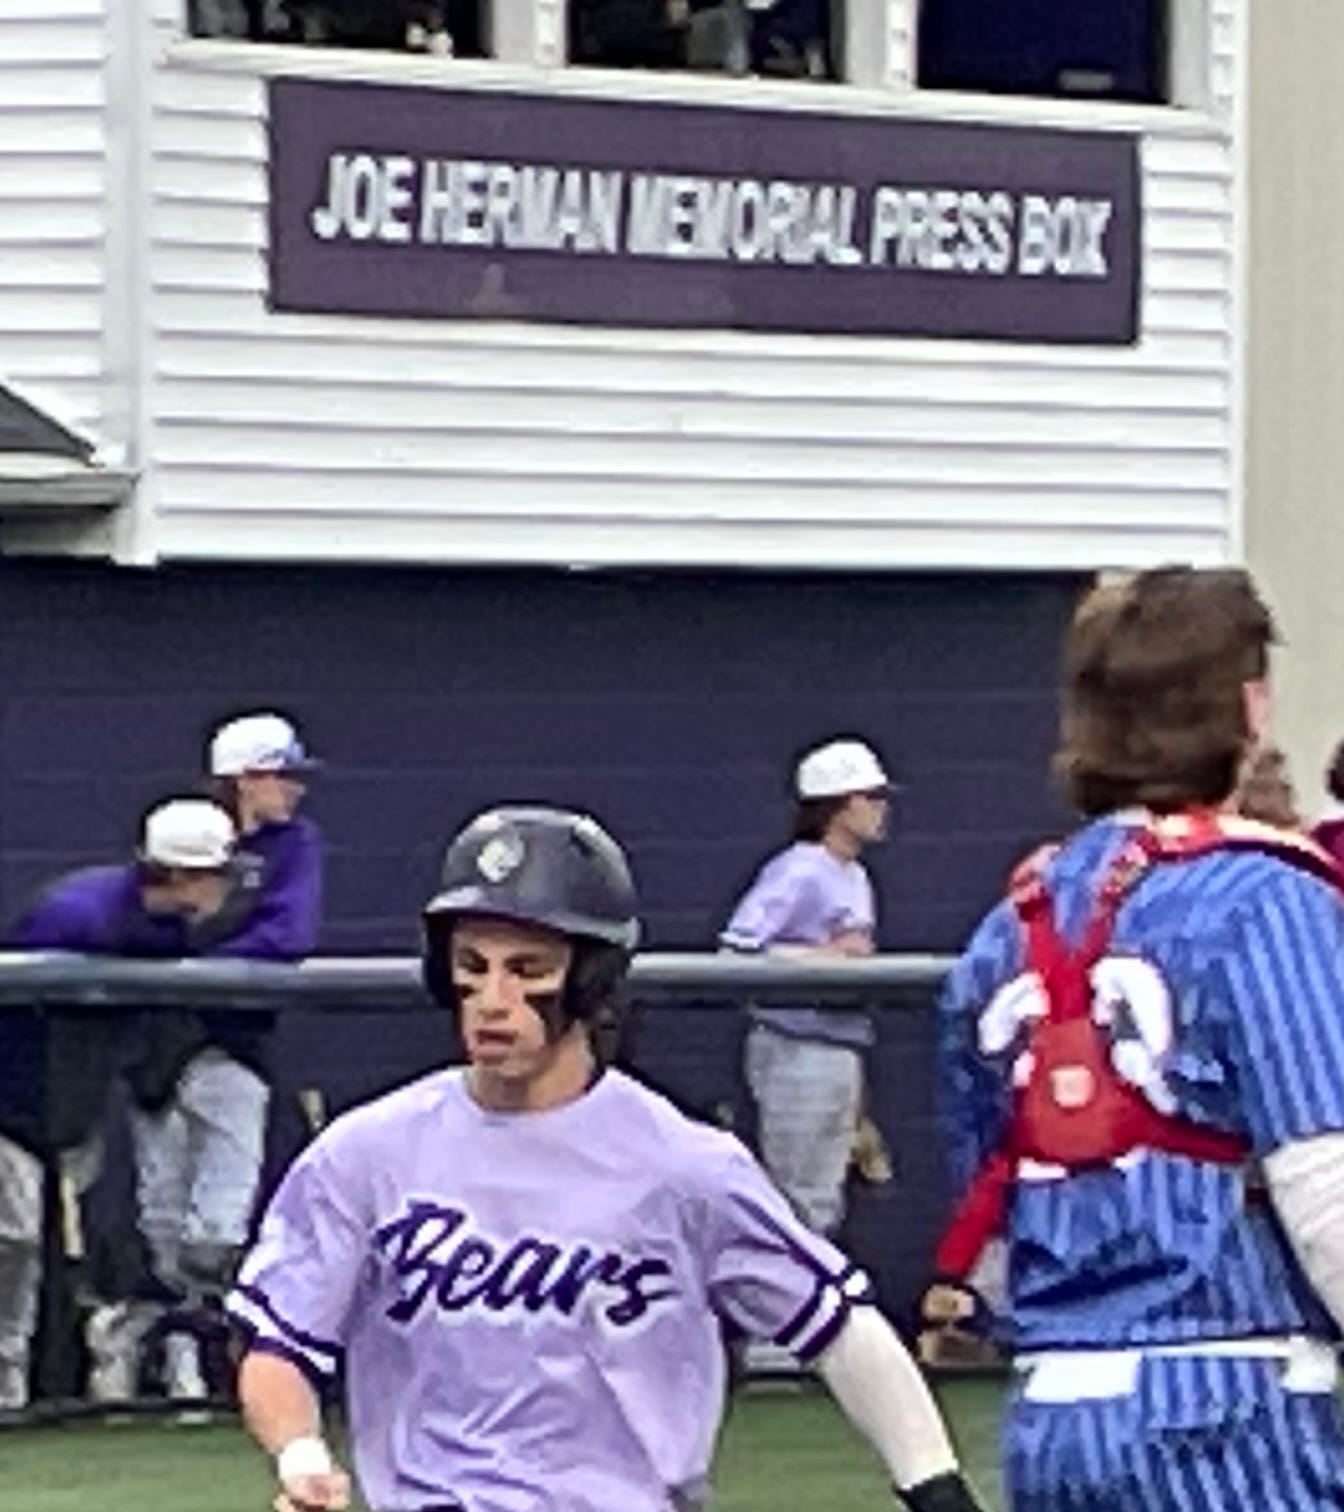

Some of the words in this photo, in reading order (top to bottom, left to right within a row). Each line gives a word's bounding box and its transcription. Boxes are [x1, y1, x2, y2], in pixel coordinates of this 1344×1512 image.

[313, 154, 416, 242] JOE
[419, 160, 623, 255] HERMAN
[626, 173, 863, 267] MEMORIAL
[869, 186, 1015, 274] PRESS
[1018, 195, 1113, 276] BOX
[371, 1200, 681, 1326] Bears
